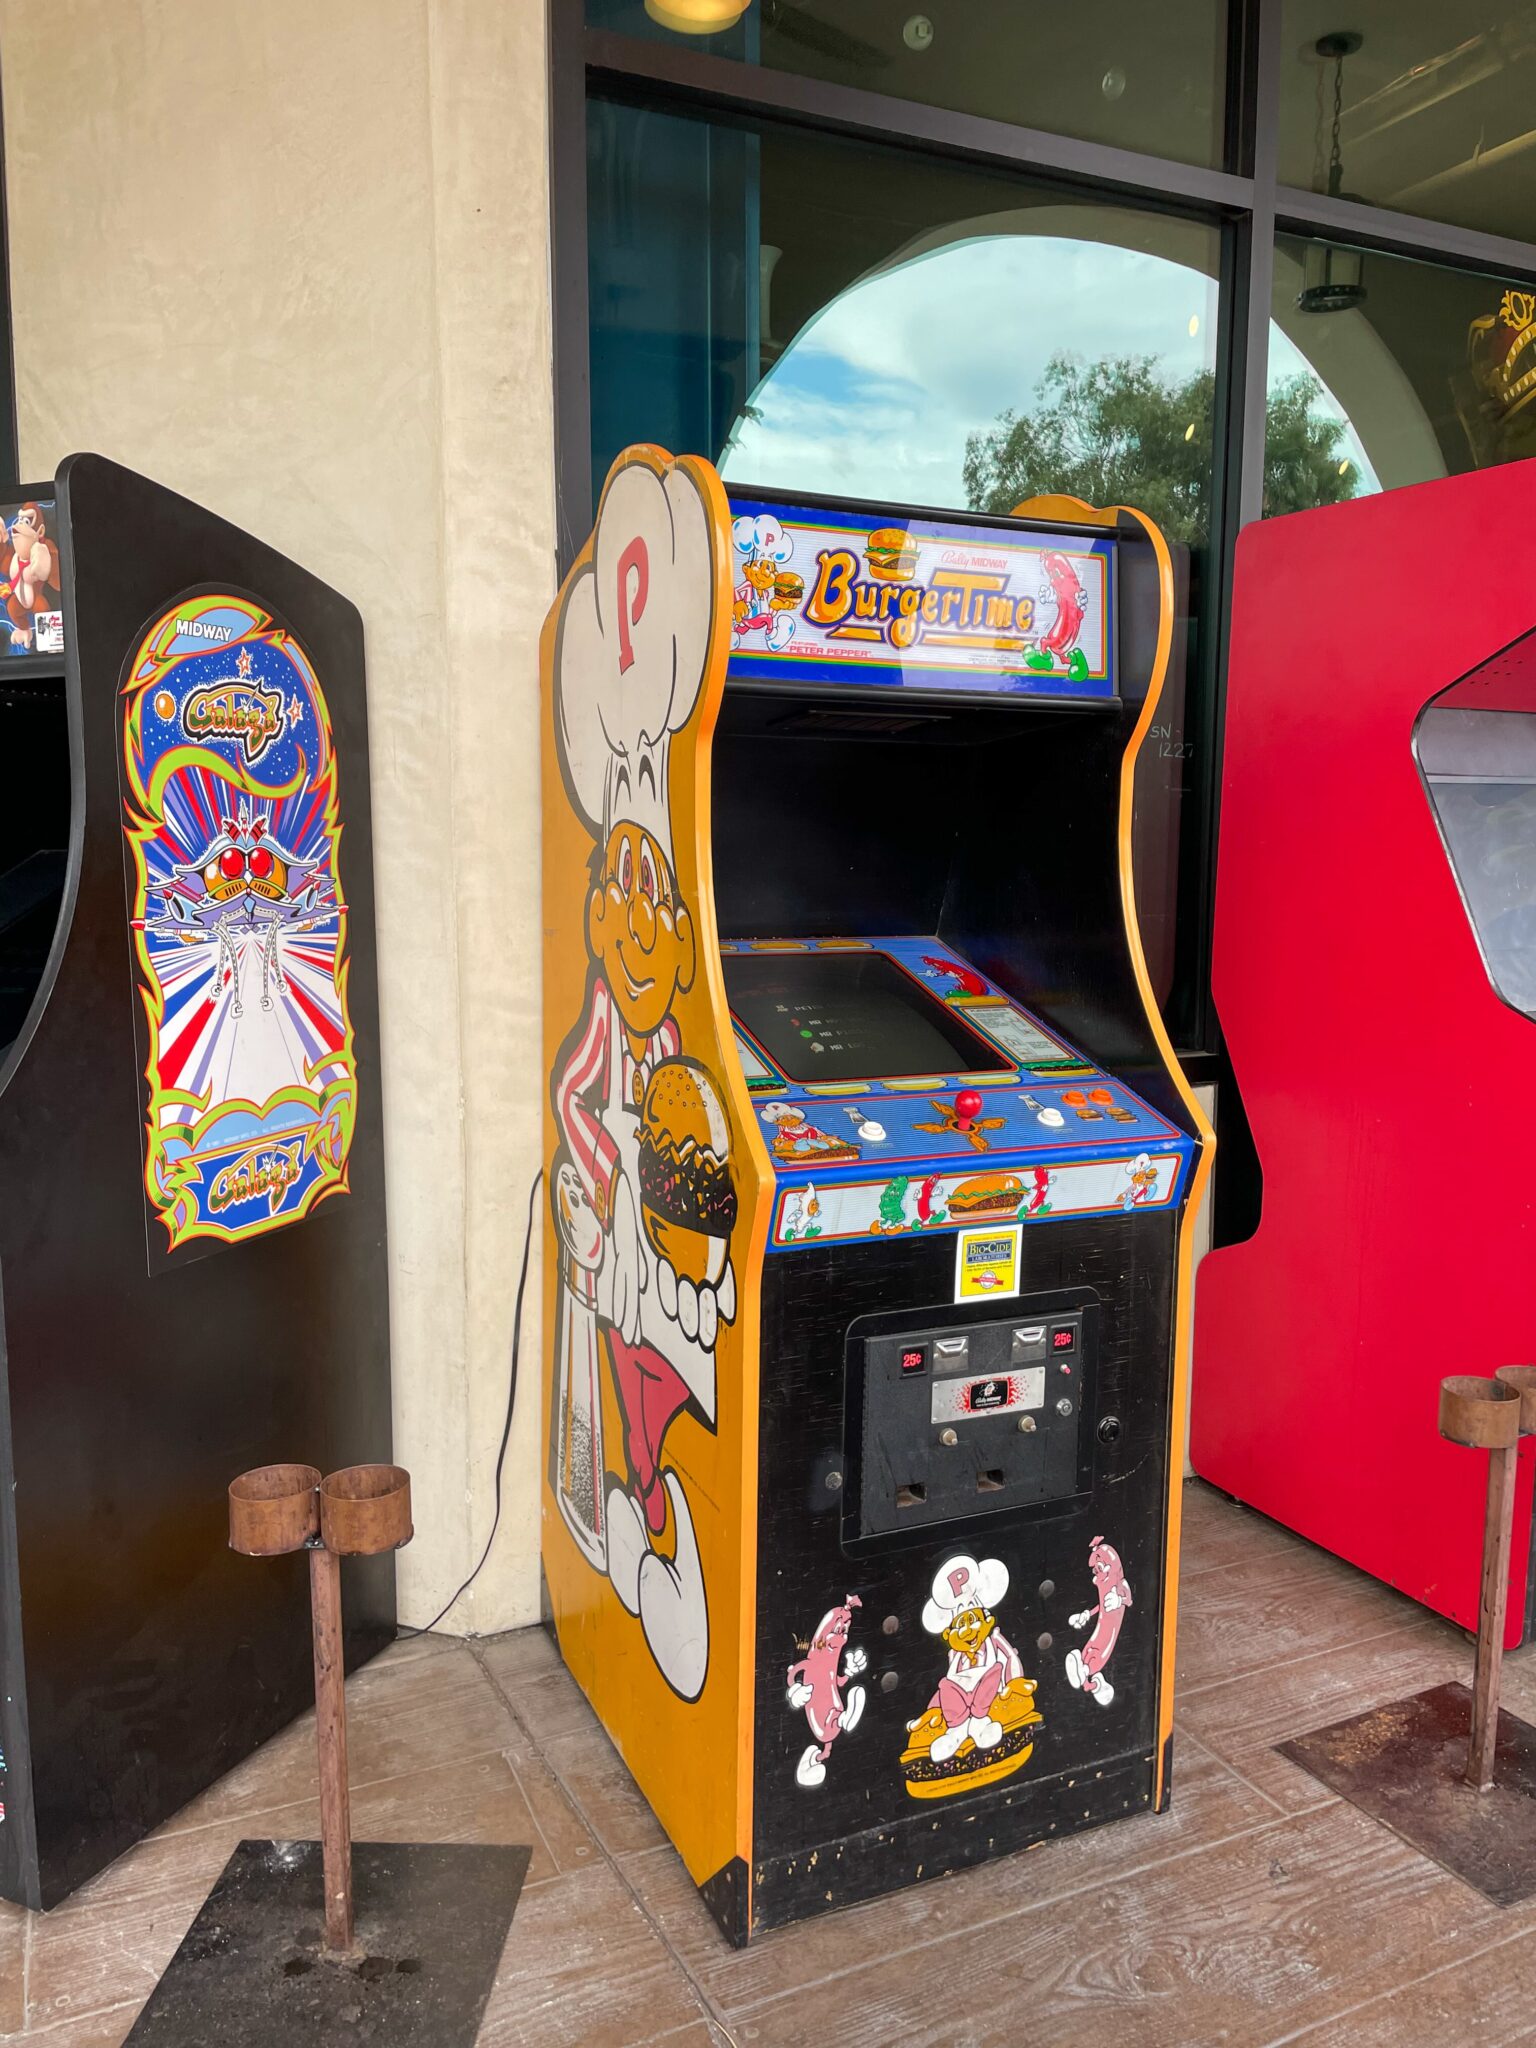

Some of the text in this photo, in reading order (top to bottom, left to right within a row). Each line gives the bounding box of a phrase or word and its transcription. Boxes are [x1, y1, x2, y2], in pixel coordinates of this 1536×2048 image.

[765, 533, 775, 546] P
[942, 550, 1008, 569] Bally MIDWAY
[803, 548, 1036, 650] BurgerTime
[176, 619, 232, 642] MIDWAY
[186, 684, 280, 756] Galaga
[1159, 742, 1194, 758] 1227
[209, 1141, 302, 1216] Galaga
[1054, 1333, 1072, 1347] 25¢
[903, 1353, 922, 1367] 25¢
[947, 1567, 970, 1598] P
